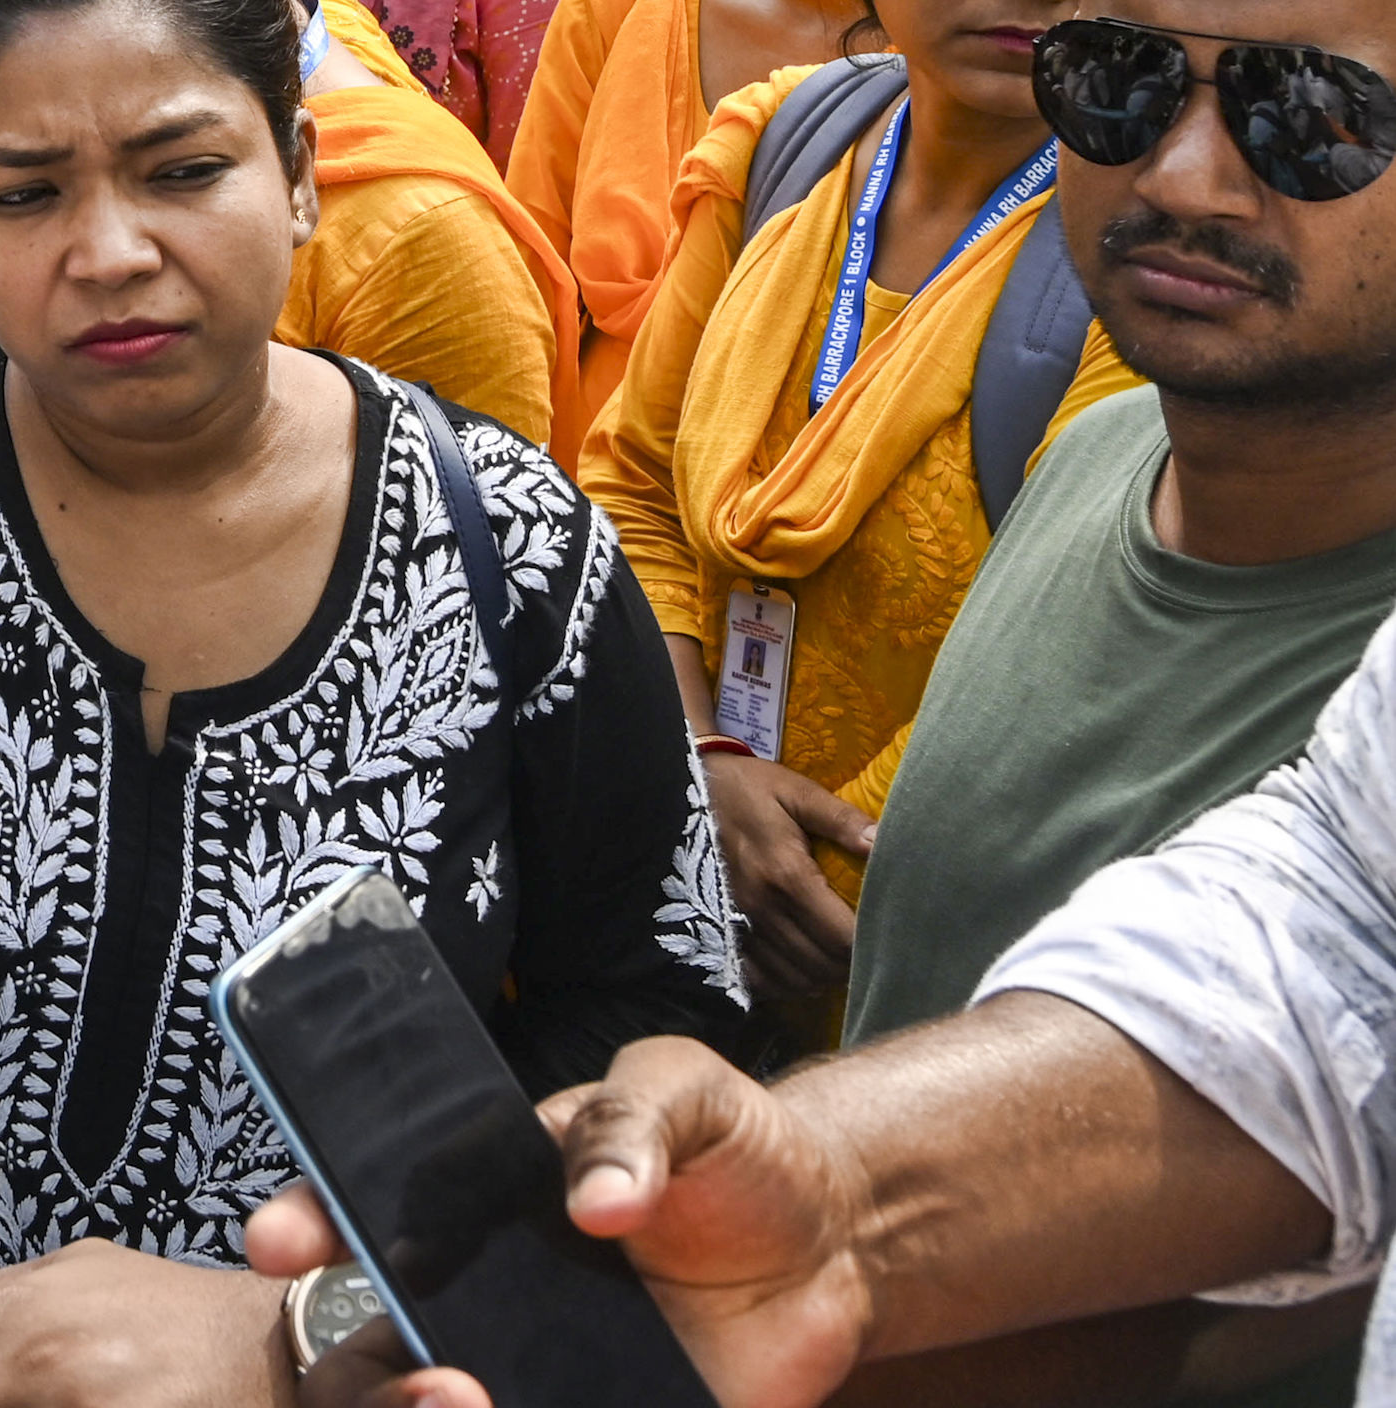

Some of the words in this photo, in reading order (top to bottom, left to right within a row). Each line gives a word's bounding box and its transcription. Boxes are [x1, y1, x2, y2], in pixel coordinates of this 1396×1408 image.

[875, 148, 890, 167] RH
[860, 168, 885, 211] NANNA
[846, 231, 867, 276] BLOCK
[843, 278, 857, 286] 1
[821, 289, 856, 383] BARRACKPORE
